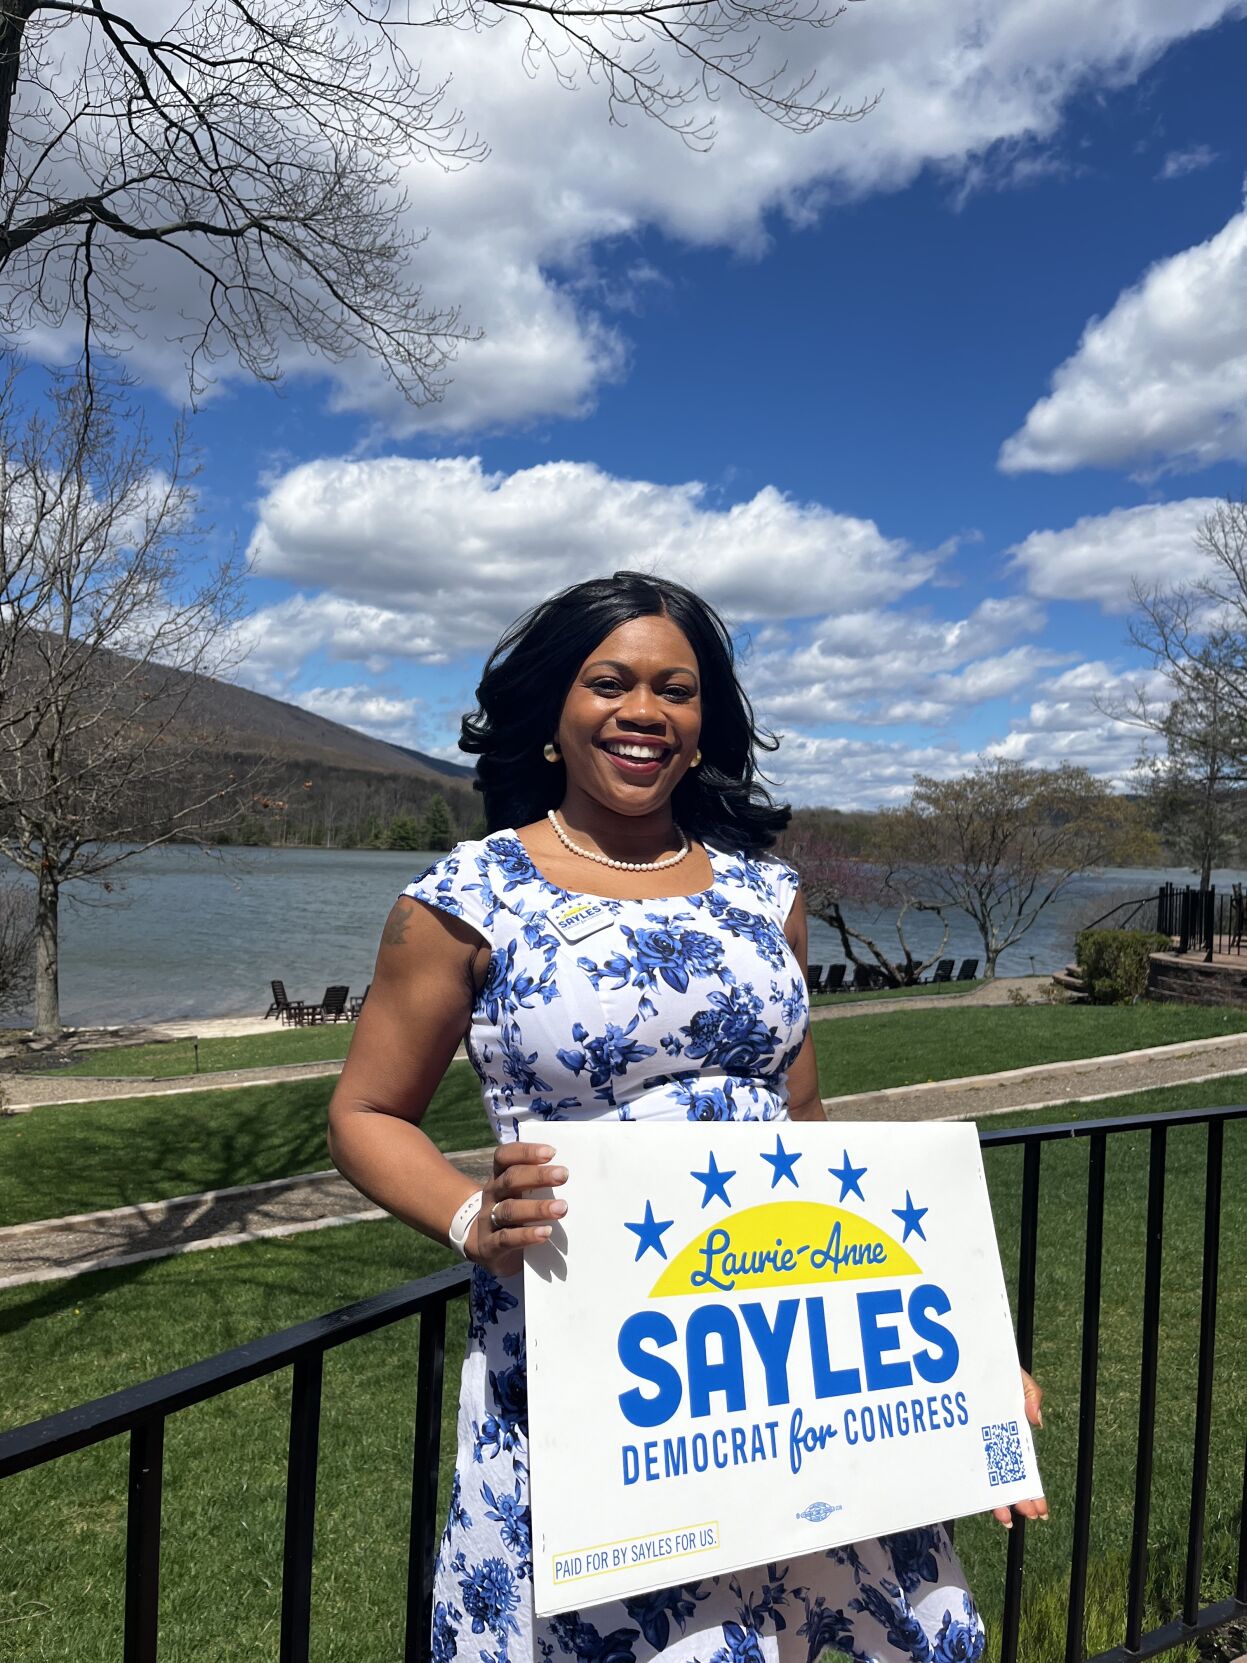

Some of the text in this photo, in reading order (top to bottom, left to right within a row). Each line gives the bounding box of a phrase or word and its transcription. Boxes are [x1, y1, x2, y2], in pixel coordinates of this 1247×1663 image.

[558, 905, 602, 928] SAYLES
[690, 1221, 887, 1291] Laurie-Anne
[617, 1283, 960, 1428] SAYLES
[621, 1391, 969, 1486] DEMOCRAT for CONGRESS
[555, 1528, 717, 1580] PAID FOR BY SAYLES FOR US.
